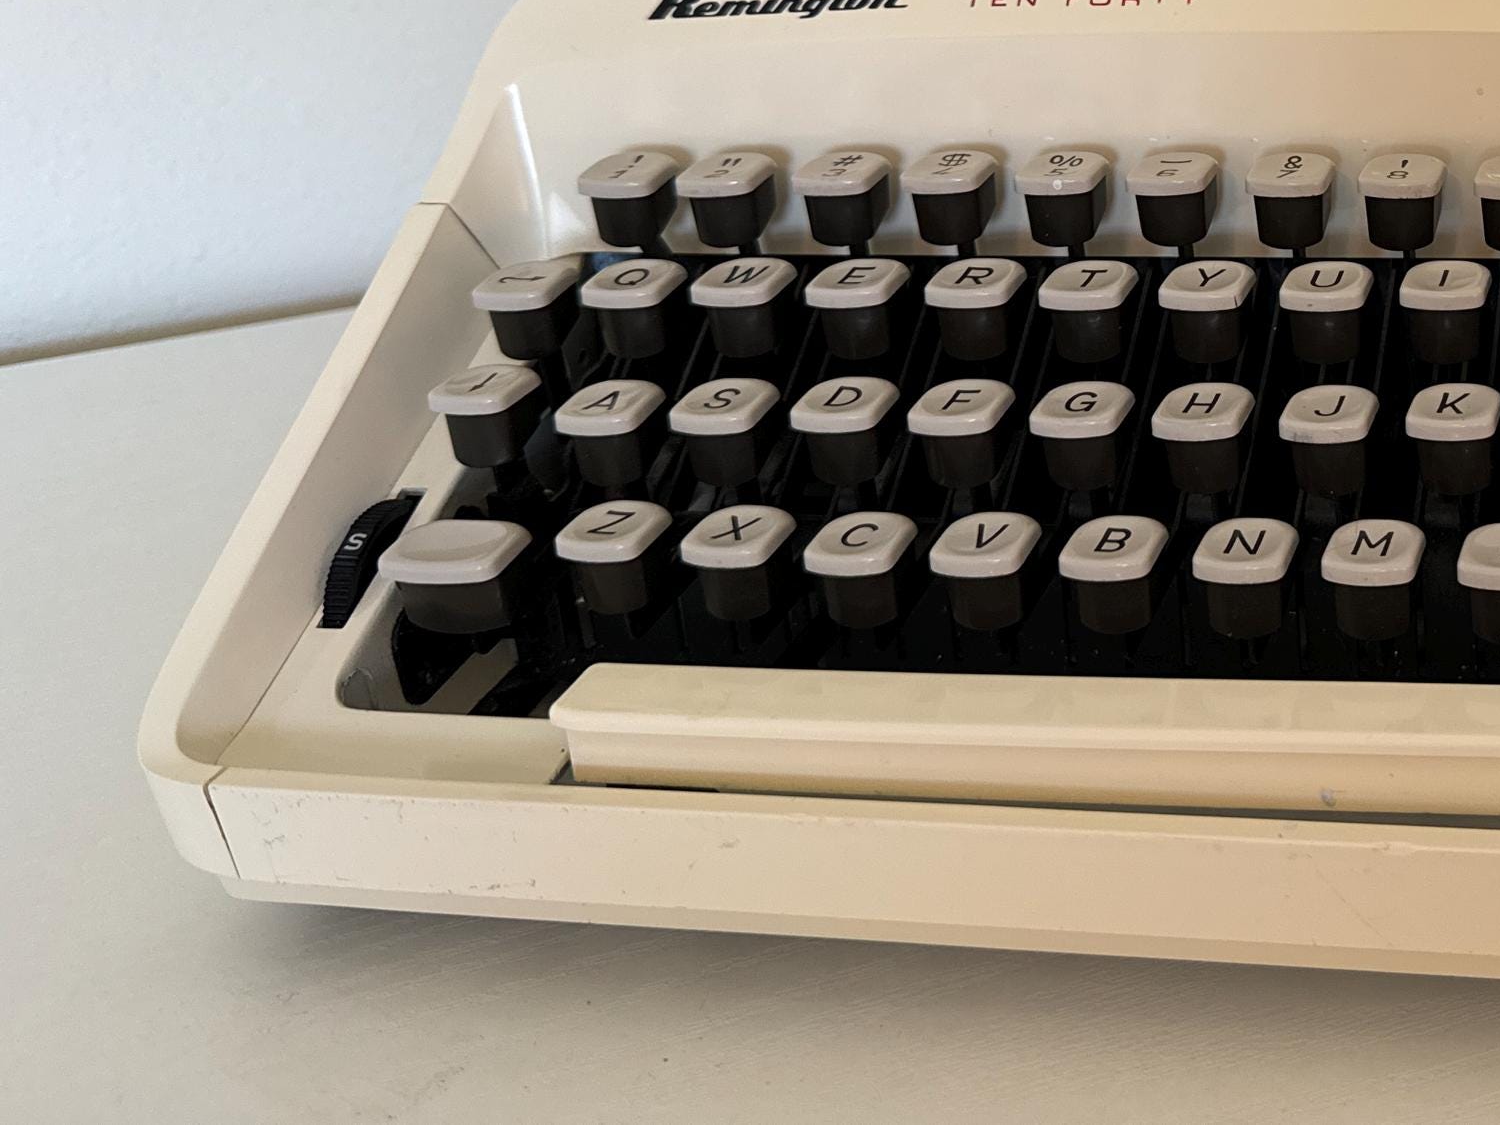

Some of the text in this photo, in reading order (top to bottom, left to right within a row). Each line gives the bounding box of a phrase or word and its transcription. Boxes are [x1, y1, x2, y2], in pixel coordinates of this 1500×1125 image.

[1048, 154, 1084, 167] %
[1283, 155, 1303, 170] &
[1386, 170, 1409, 179] 8
[613, 268, 650, 287] Q
[722, 265, 770, 284] W
[836, 266, 877, 285] E
[954, 266, 994, 285] R
[1079, 269, 1109, 288] T
[1198, 267, 1227, 288] Y
[1309, 269, 1345, 288] U
[1438, 269, 1450, 288] I
[582, 389, 620, 411] A
[703, 388, 742, 410] S
[822, 385, 863, 407] D
[941, 389, 982, 411] F
[1064, 391, 1098, 413] G
[1181, 392, 1222, 414] H
[1313, 395, 1346, 417] J
[1435, 392, 1471, 415] K
[586, 510, 636, 536] Z
[710, 515, 762, 542] X
[343, 532, 368, 551] S
[840, 523, 879, 548] C
[975, 523, 1010, 549] V
[1093, 527, 1132, 553] B
[1222, 529, 1267, 556] N
[1350, 530, 1394, 557] M
